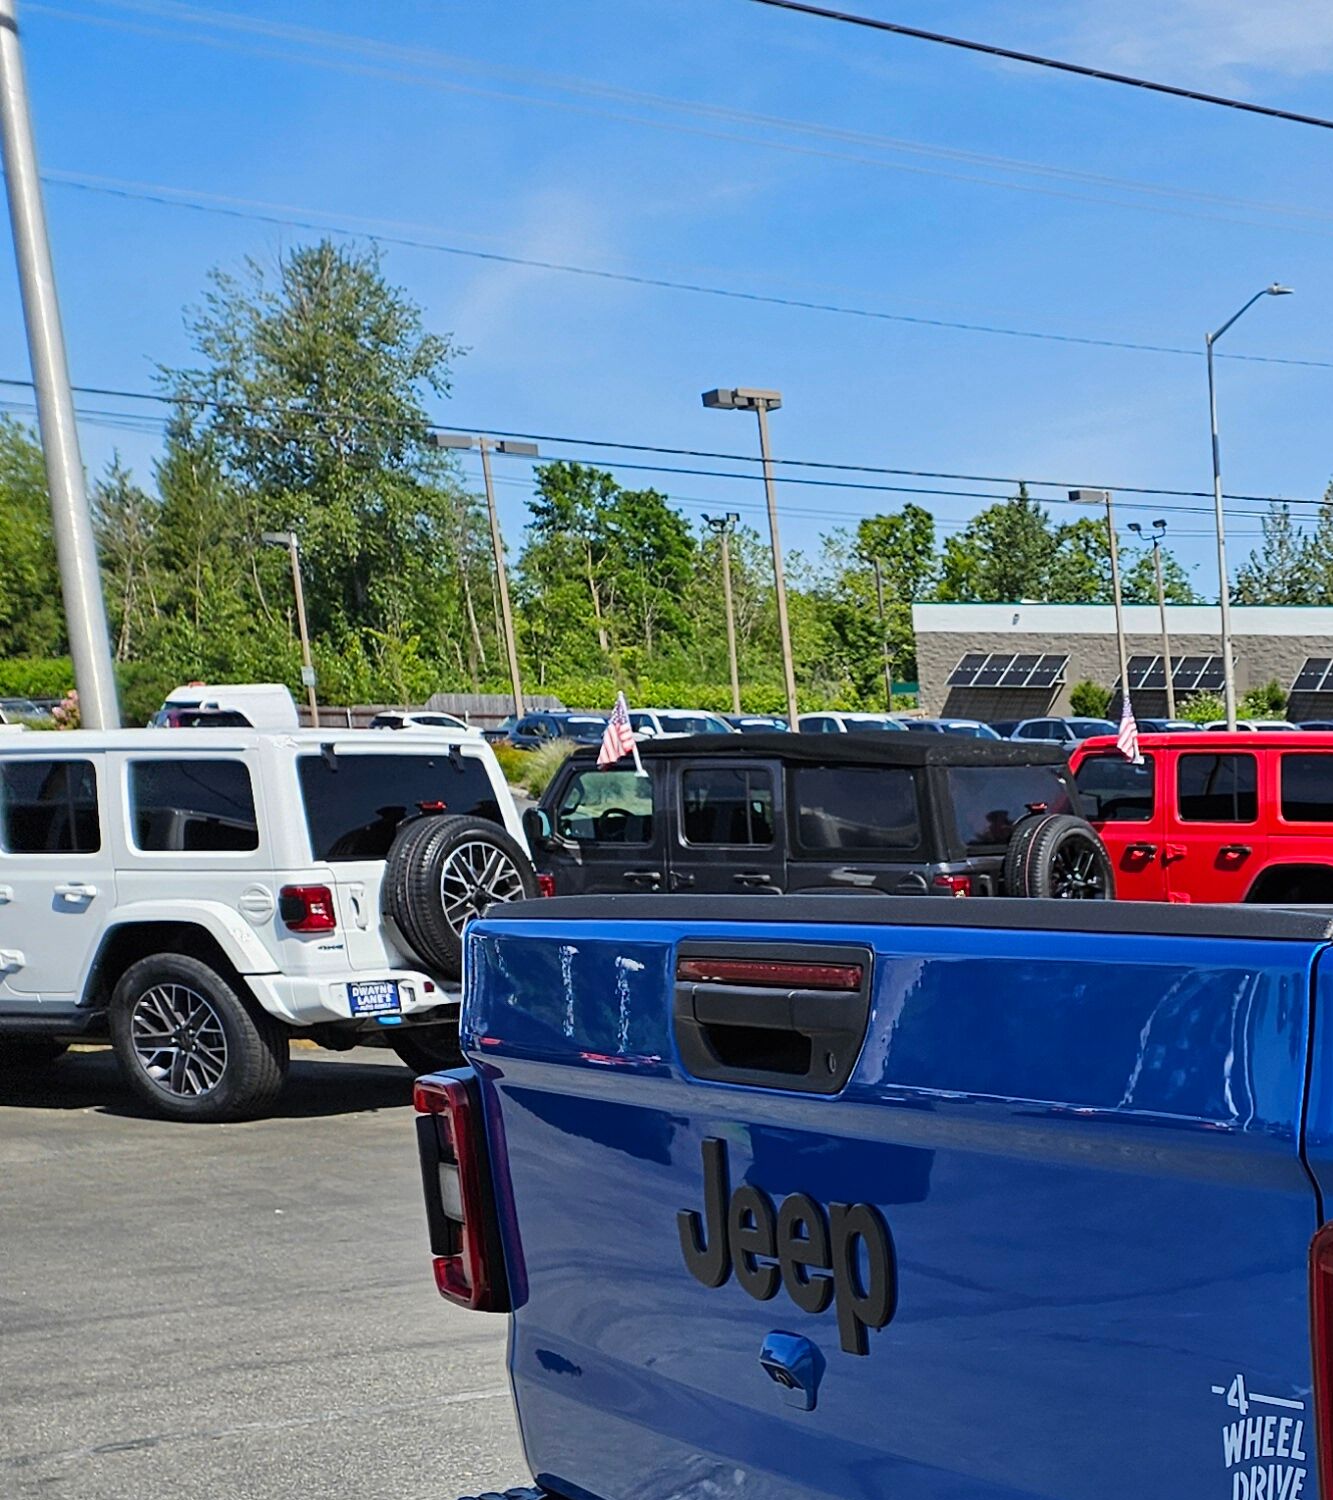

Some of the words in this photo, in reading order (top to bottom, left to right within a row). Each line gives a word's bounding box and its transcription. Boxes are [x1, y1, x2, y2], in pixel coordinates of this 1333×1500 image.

[352, 983, 394, 997] DWAYNE
[676, 1135, 898, 1356] Jeep
[1222, 1416, 1305, 1468] WHEEL
